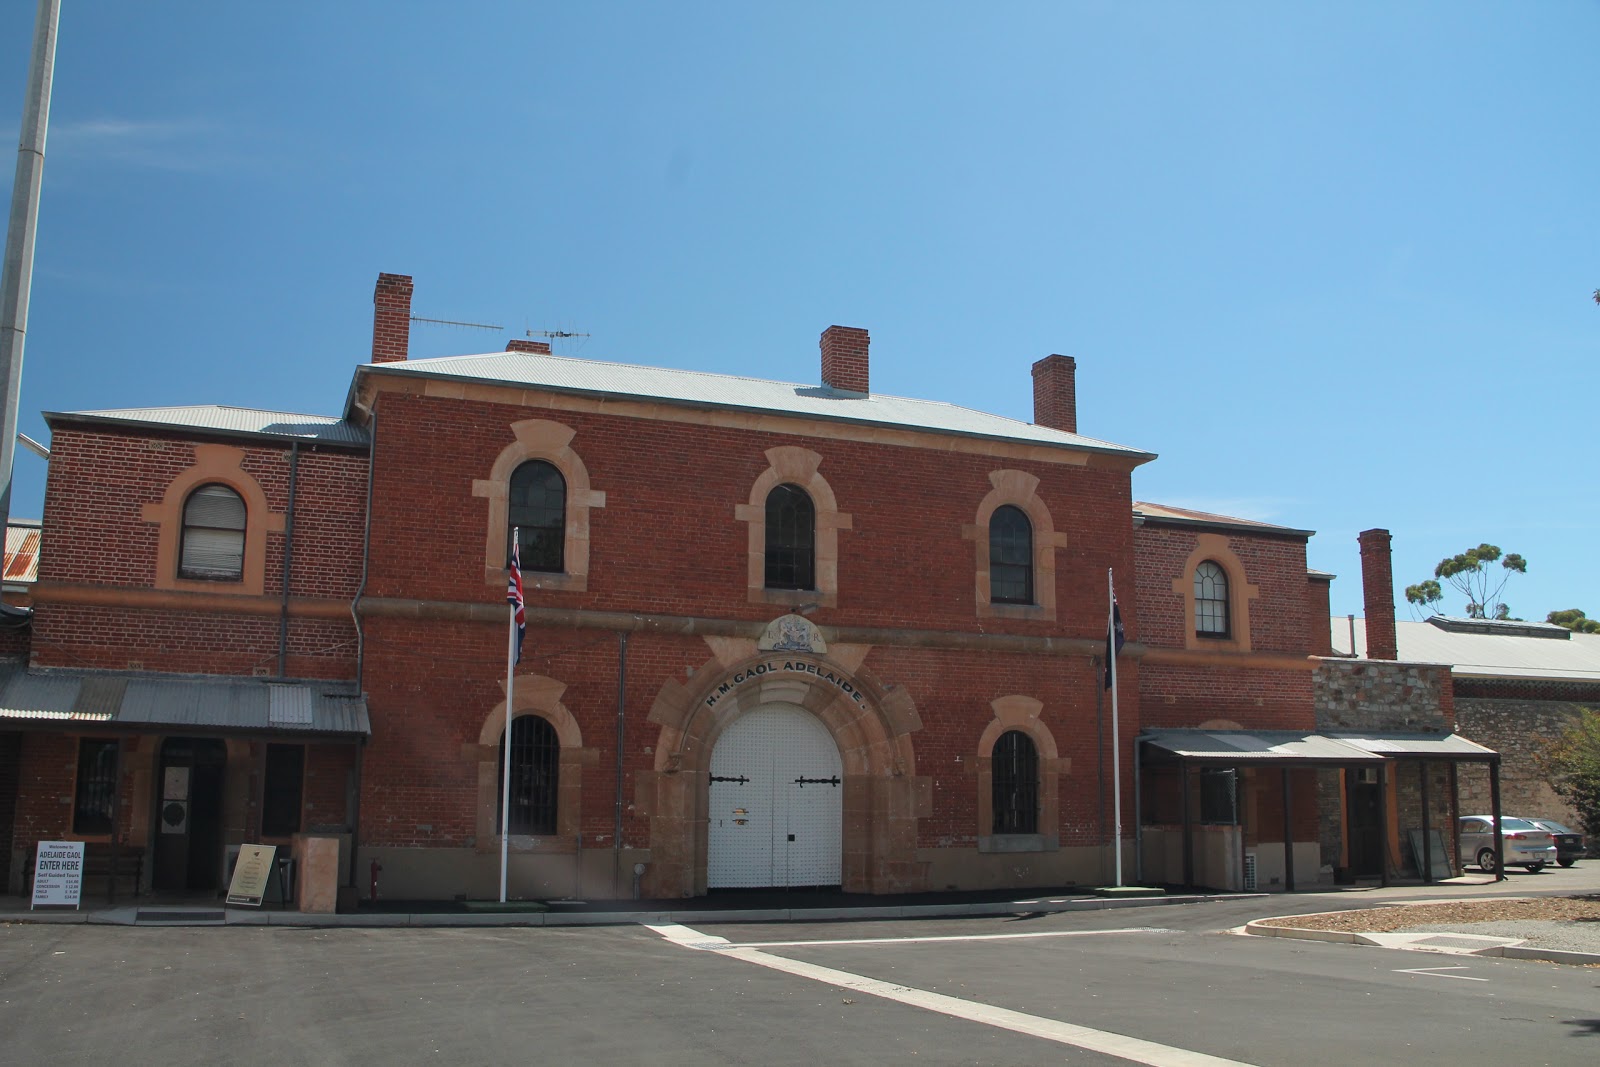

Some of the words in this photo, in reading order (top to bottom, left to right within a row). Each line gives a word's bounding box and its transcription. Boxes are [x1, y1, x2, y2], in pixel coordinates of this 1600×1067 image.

[66, 851, 81, 859] GAOL
[39, 860, 61, 870] ENTER
[61, 861, 79, 870] HERE
